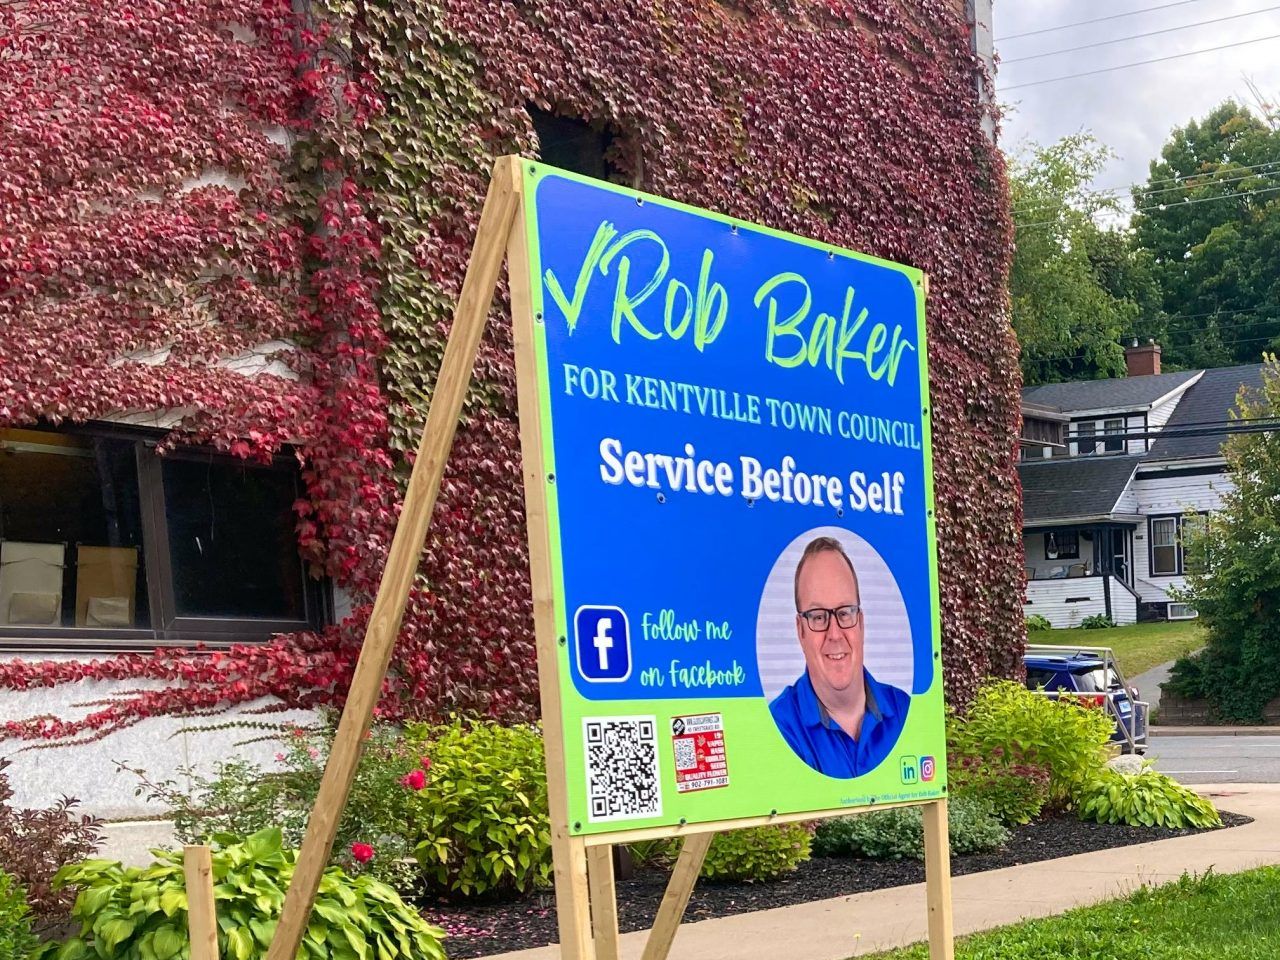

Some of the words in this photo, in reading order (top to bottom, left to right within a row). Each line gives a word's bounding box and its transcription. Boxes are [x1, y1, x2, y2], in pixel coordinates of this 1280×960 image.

[599, 230, 728, 352] Rob
[754, 272, 915, 387] Baker
[563, 363, 620, 402] FOR
[624, 374, 761, 427] KENTVILLE
[765, 398, 832, 437] TOWN
[838, 411, 921, 450] COUNCIL
[599, 437, 733, 497] Service
[740, 455, 843, 508] Before
[849, 471, 904, 516] Self
[705, 620, 732, 641] me
[640, 667, 664, 687] on
